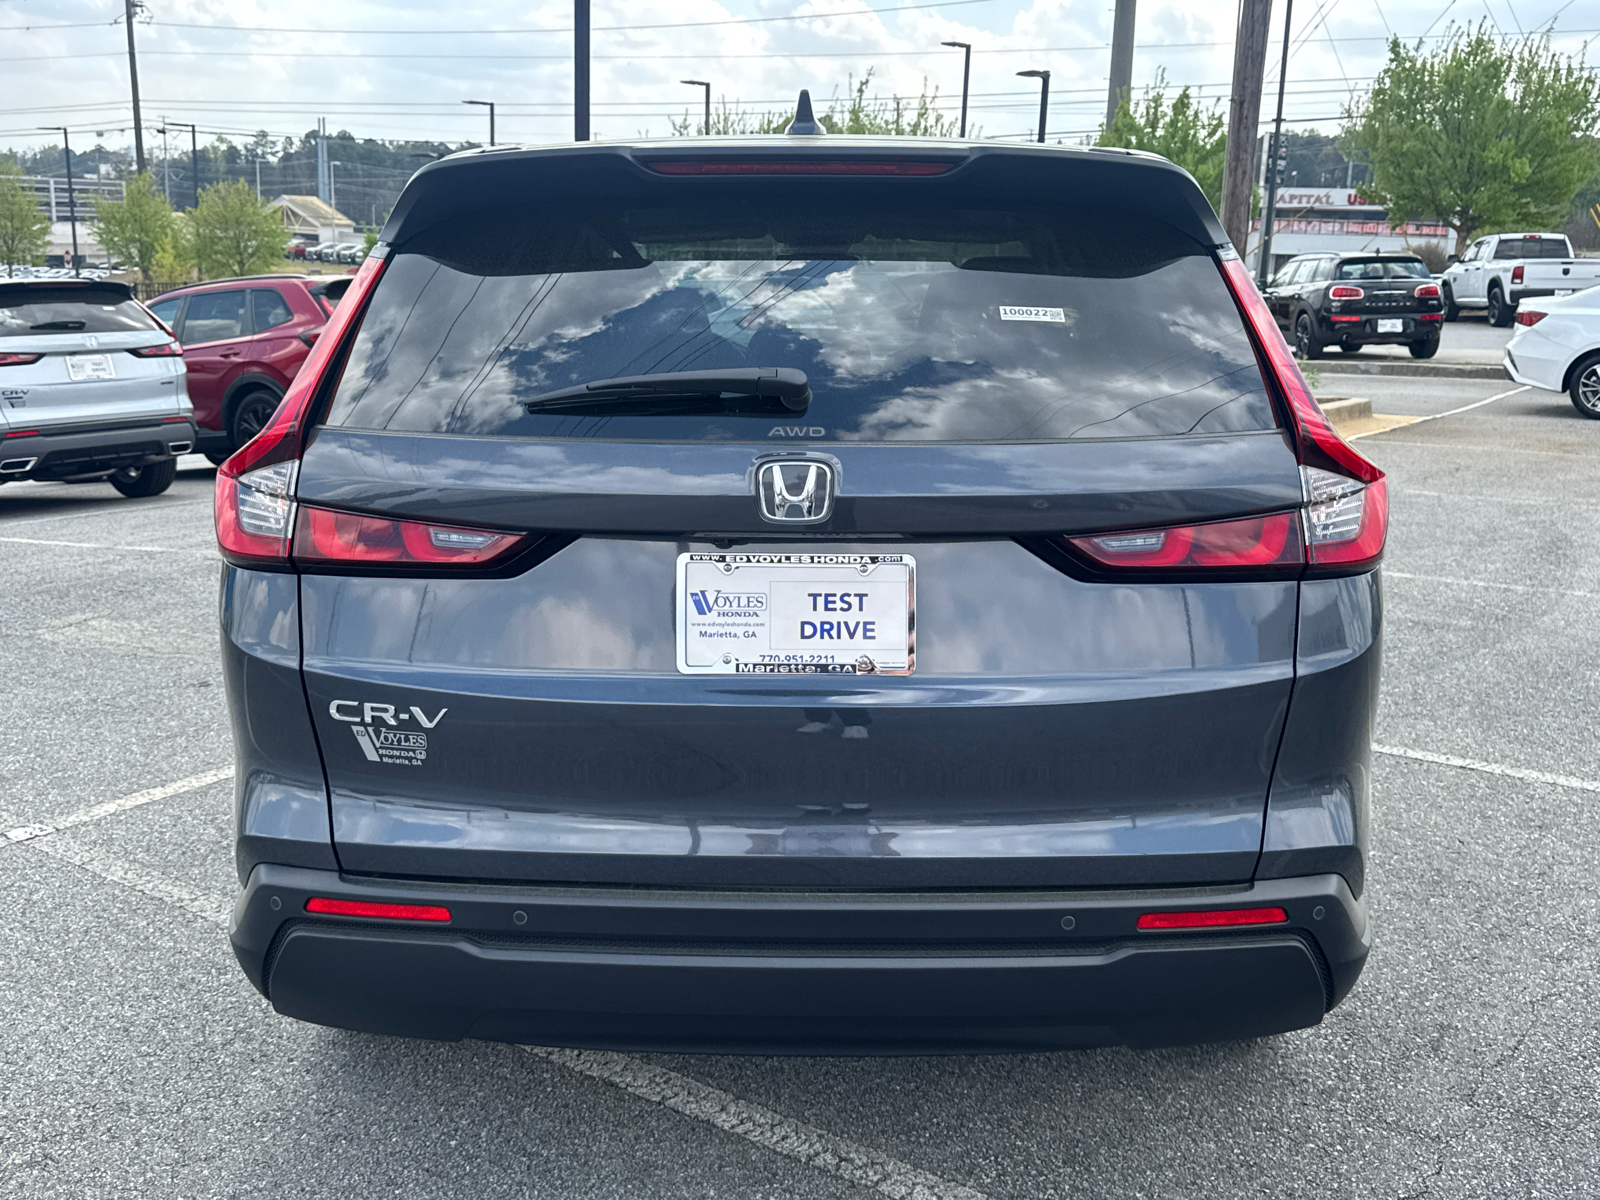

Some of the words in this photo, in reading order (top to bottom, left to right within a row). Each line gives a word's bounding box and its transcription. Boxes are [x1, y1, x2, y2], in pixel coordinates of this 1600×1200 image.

[1276, 193, 1334, 205] APITAL
[1002, 308, 1049, 317] 100022
[767, 426, 826, 437] AWD
[807, 592, 869, 612] TEST
[699, 630, 740, 639] Marietta,
[743, 631, 757, 639] GA
[800, 620, 876, 640] DRIVE
[758, 654, 836, 663] 770-951-2211
[738, 663, 821, 673] Marietta,
[828, 663, 854, 673] GA
[329, 699, 449, 729] CR-V
[355, 729, 367, 737] ED
[378, 748, 416, 757] HONDA
[382, 756, 411, 766] Marietta,
